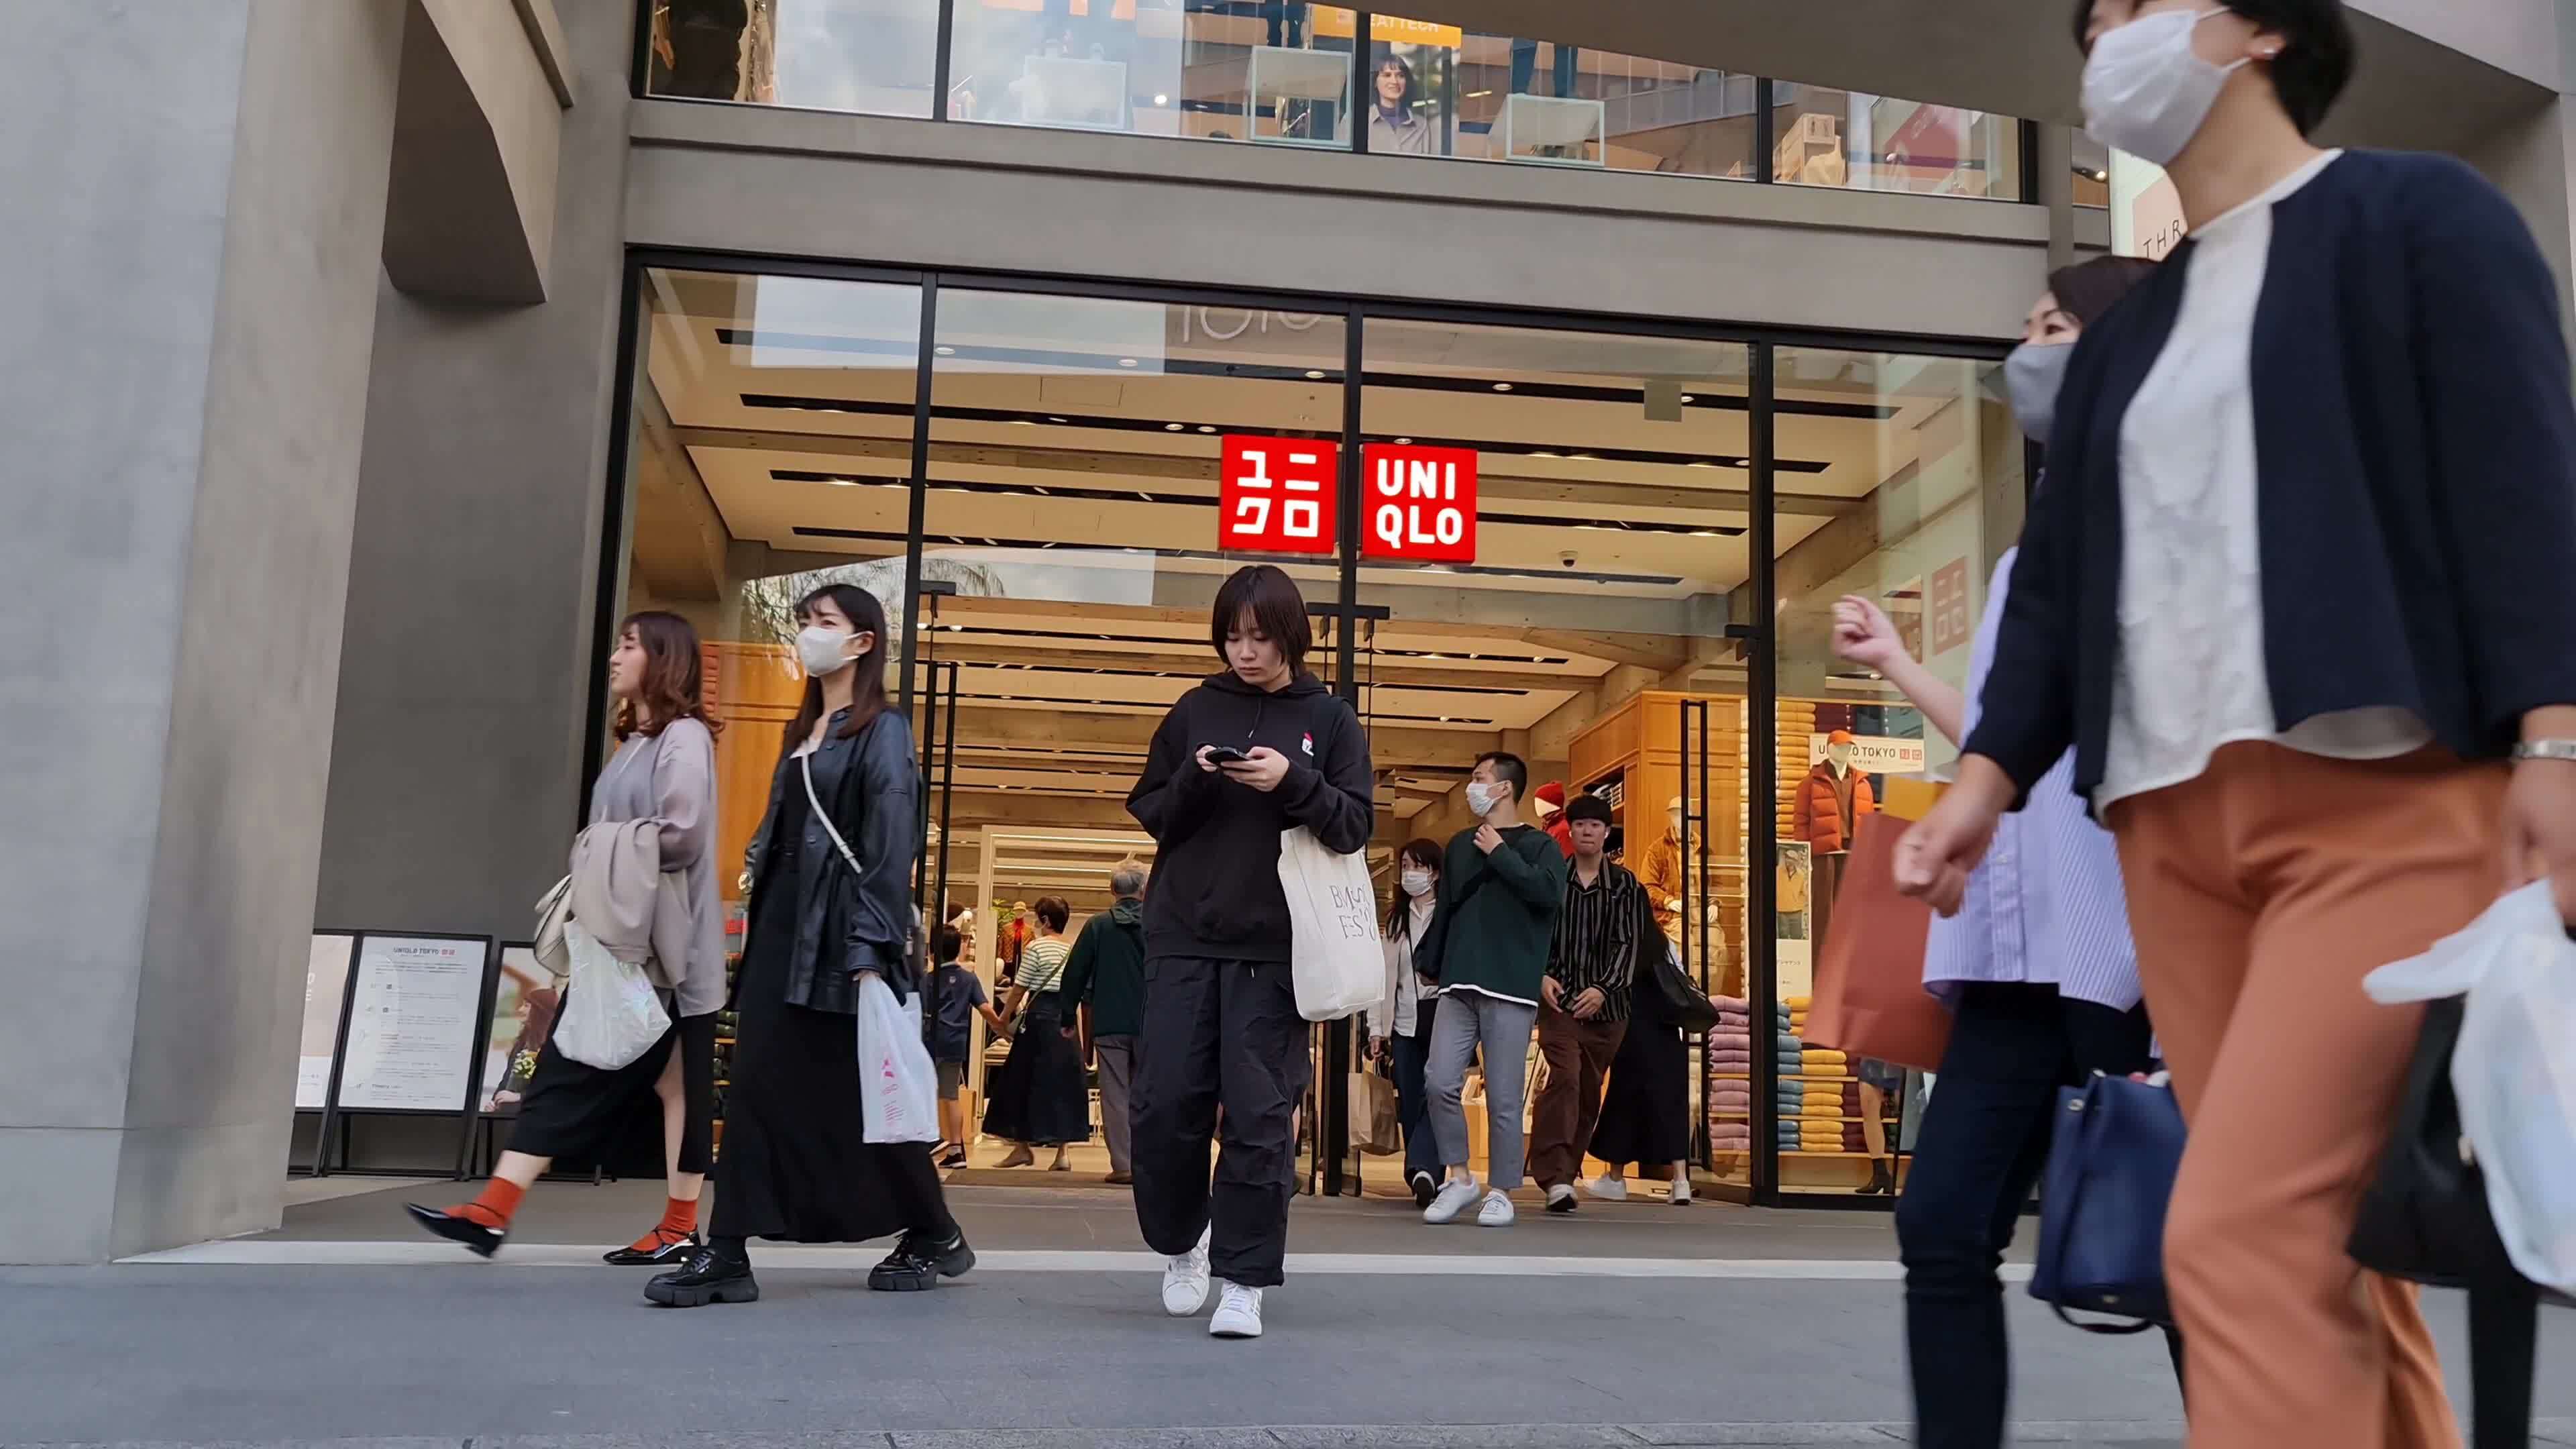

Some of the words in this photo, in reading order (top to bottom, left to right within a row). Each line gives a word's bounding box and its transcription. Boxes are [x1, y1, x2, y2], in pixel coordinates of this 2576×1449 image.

[1377, 458, 1456, 500] UNI
[1232, 496, 1320, 537] クロ
[1376, 504, 1463, 549] QLO
[1862, 747, 1896, 757] TOKYO
